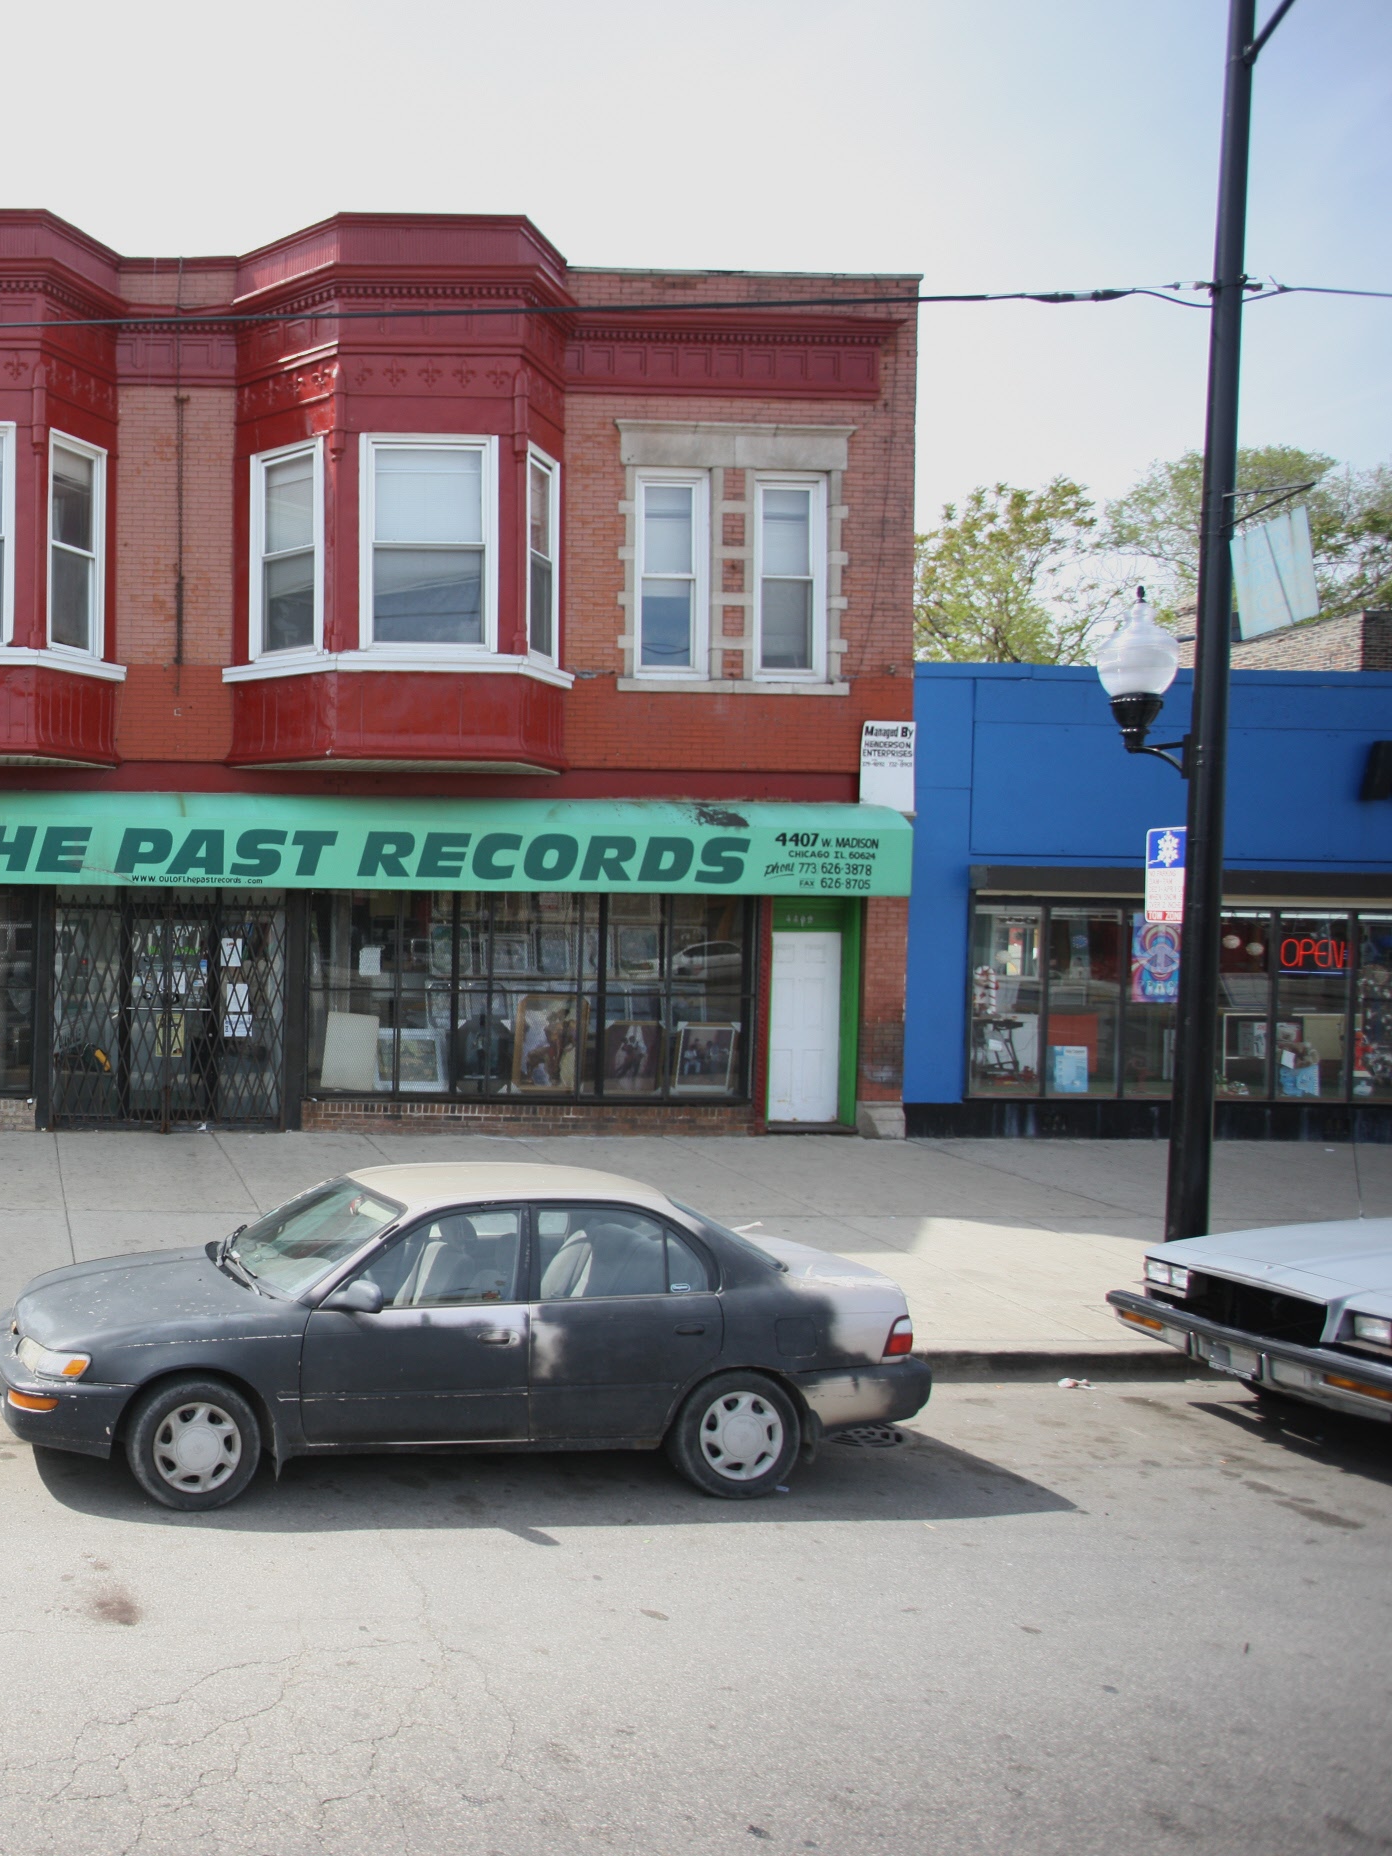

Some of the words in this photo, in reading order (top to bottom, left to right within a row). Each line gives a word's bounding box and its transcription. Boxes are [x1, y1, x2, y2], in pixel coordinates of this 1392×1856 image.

[864, 726, 899, 739] Managed
[901, 726, 914, 739] By
[774, 832, 819, 847] 4407
[836, 837, 879, 849] MADISON
[113, 827, 338, 877] PAST
[357, 831, 752, 884] RECORDS
[788, 850, 829, 859] CHICAGO
[848, 852, 876, 860] 60624
[798, 862, 817, 874] 773
[821, 862, 872, 876] 626-3878
[820, 878, 871, 889] 626-8705
[1148, 911, 1162, 920] TOW
[1280, 938, 1345, 969] OPEN
